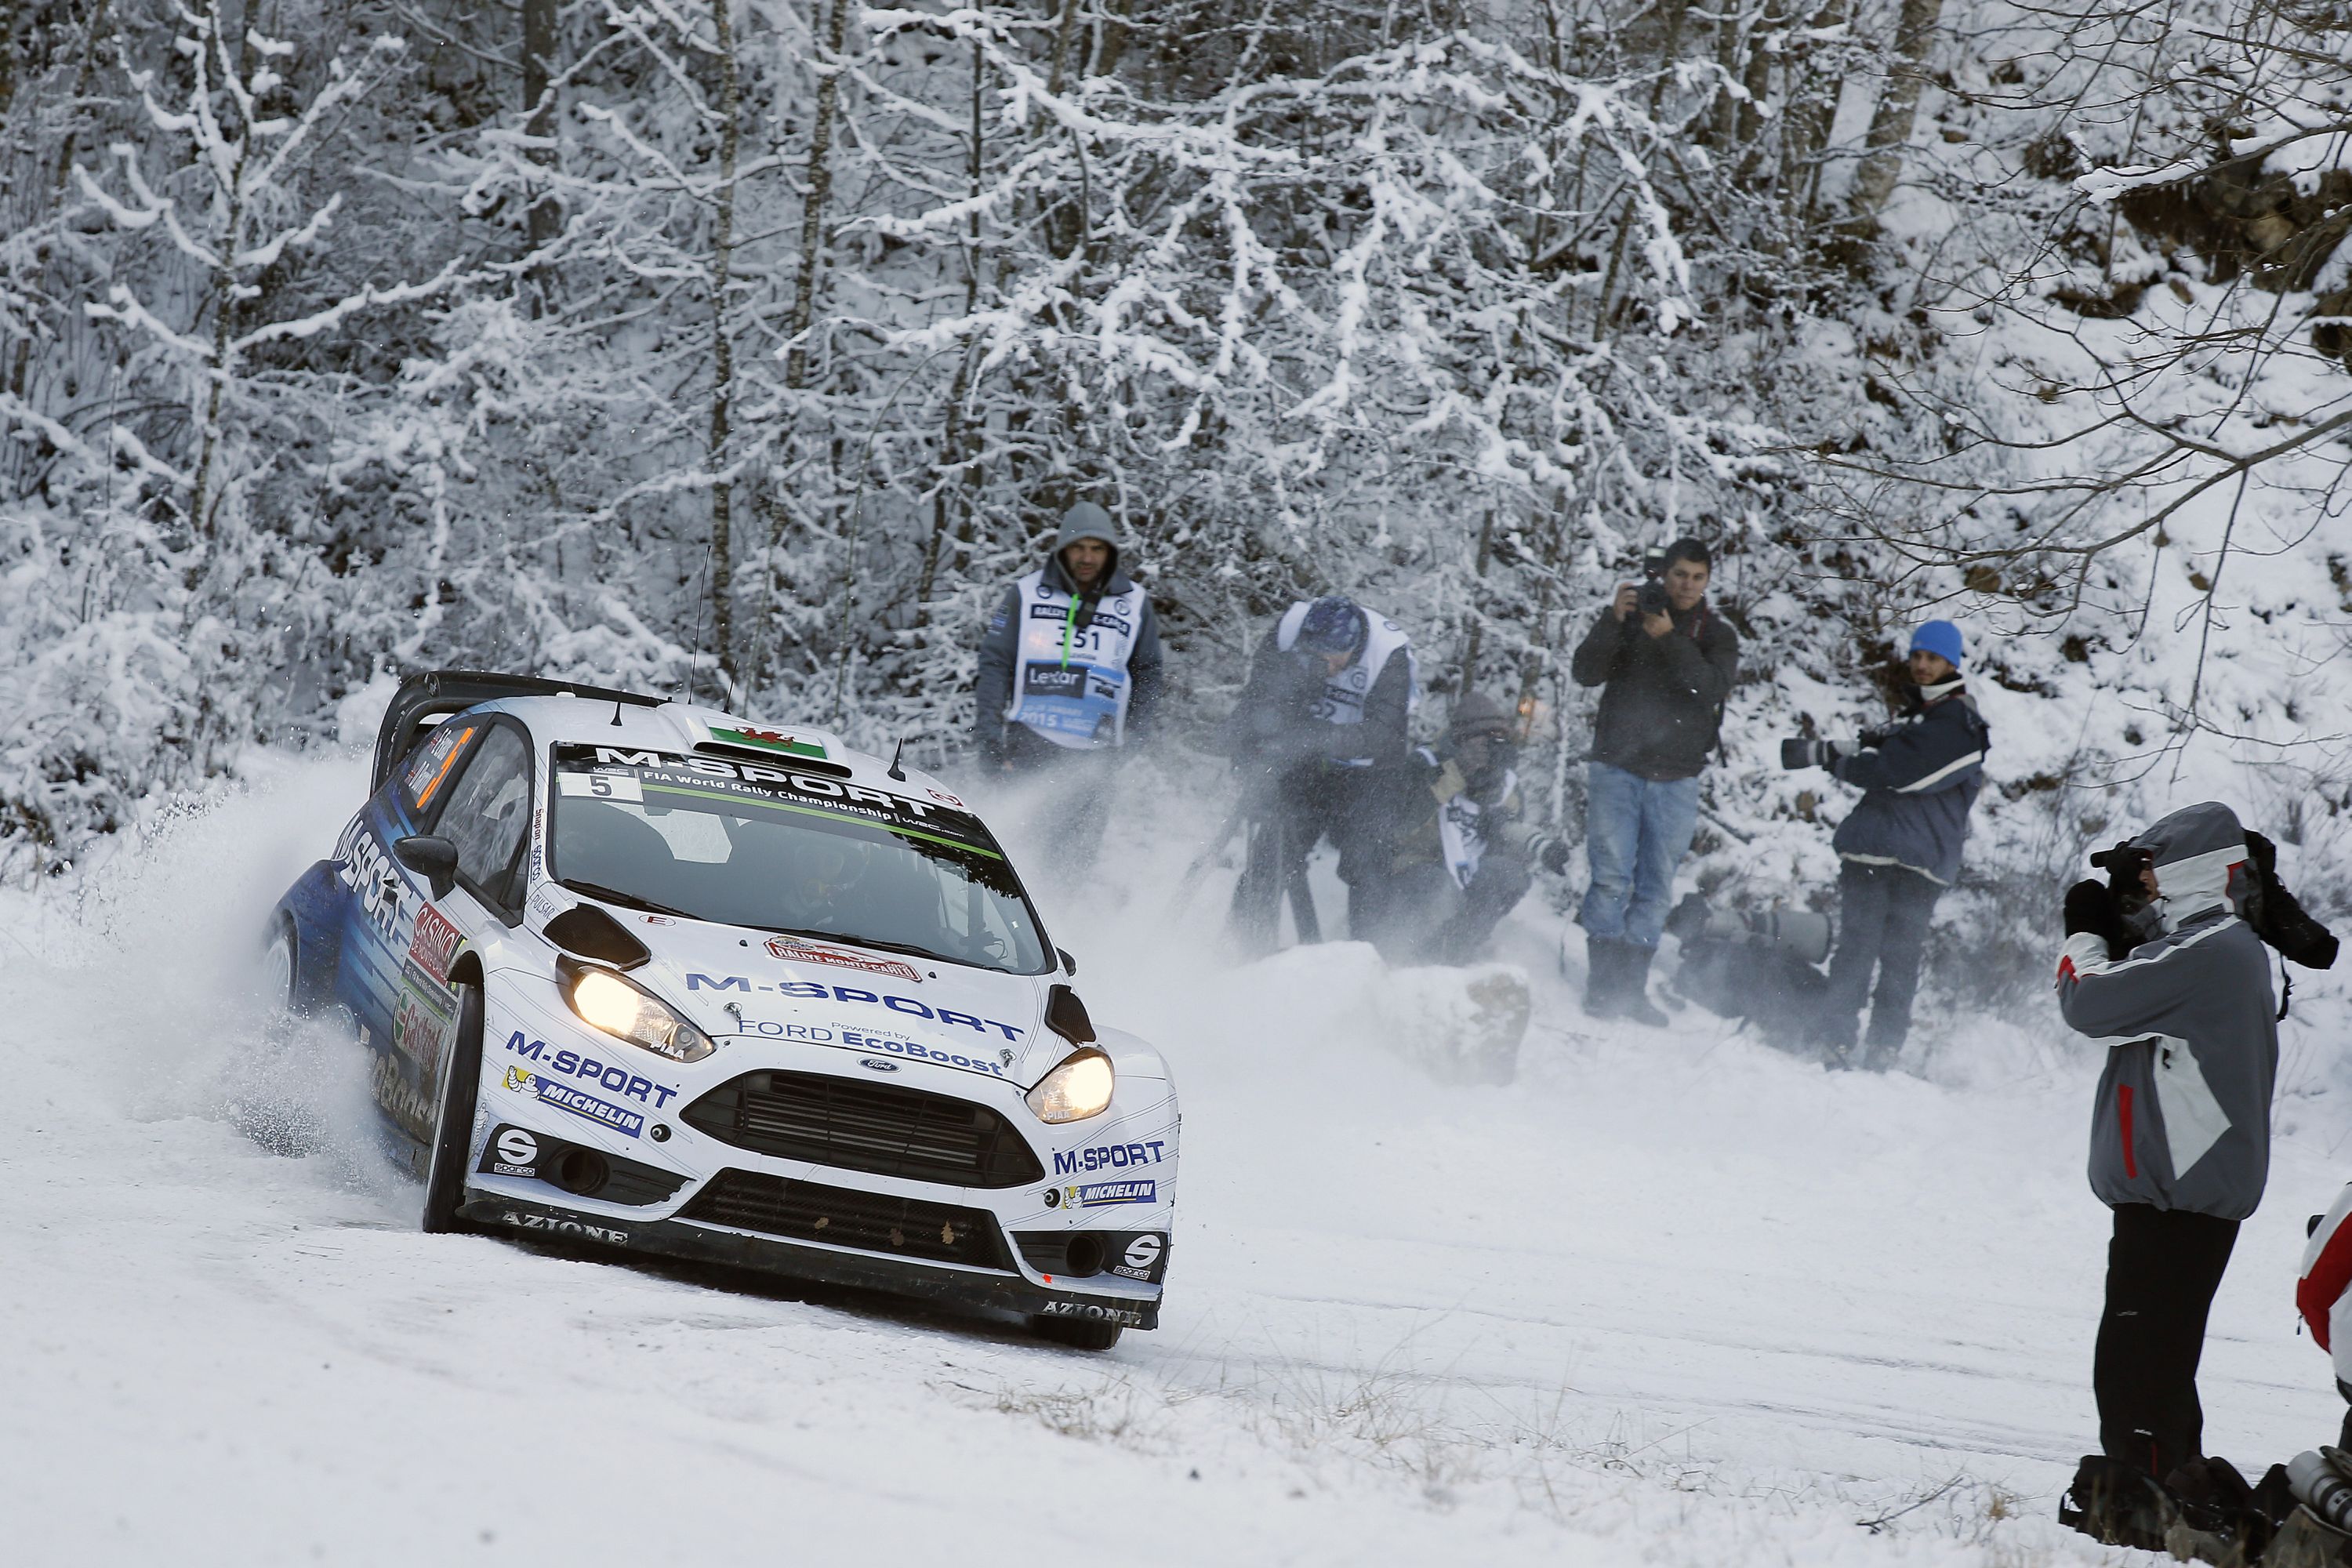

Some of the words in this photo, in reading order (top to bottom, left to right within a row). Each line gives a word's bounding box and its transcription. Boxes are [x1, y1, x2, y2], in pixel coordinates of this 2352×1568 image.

[1029, 667, 1080, 685] Lexar
[590, 775, 612, 796] 5
[595, 747, 935, 817] M-SPORT
[644, 771, 672, 782] FIA
[676, 775, 725, 789] World
[731, 783, 772, 799] Rally
[778, 790, 892, 822] Championship
[531, 895, 555, 920] PULSAR
[414, 906, 455, 961] CASINO
[775, 946, 823, 962] RALLYE
[686, 973, 1025, 1042] M-SPORT
[831, 1022, 891, 1036] Powered
[895, 1031, 910, 1041] by
[650, 1041, 684, 1059] PIAA
[739, 1019, 833, 1041] FORD
[842, 1031, 1004, 1076] EcoBoost
[505, 1030, 678, 1109] M-SPORT
[867, 1059, 892, 1070] Ford
[543, 1083, 641, 1130] MICHELIN
[495, 1163, 535, 1174] sparco
[1054, 1141, 1164, 1175] M-SPORT
[1083, 1182, 1153, 1200] MICHELIN
[1115, 1266, 1149, 1277] sparco
